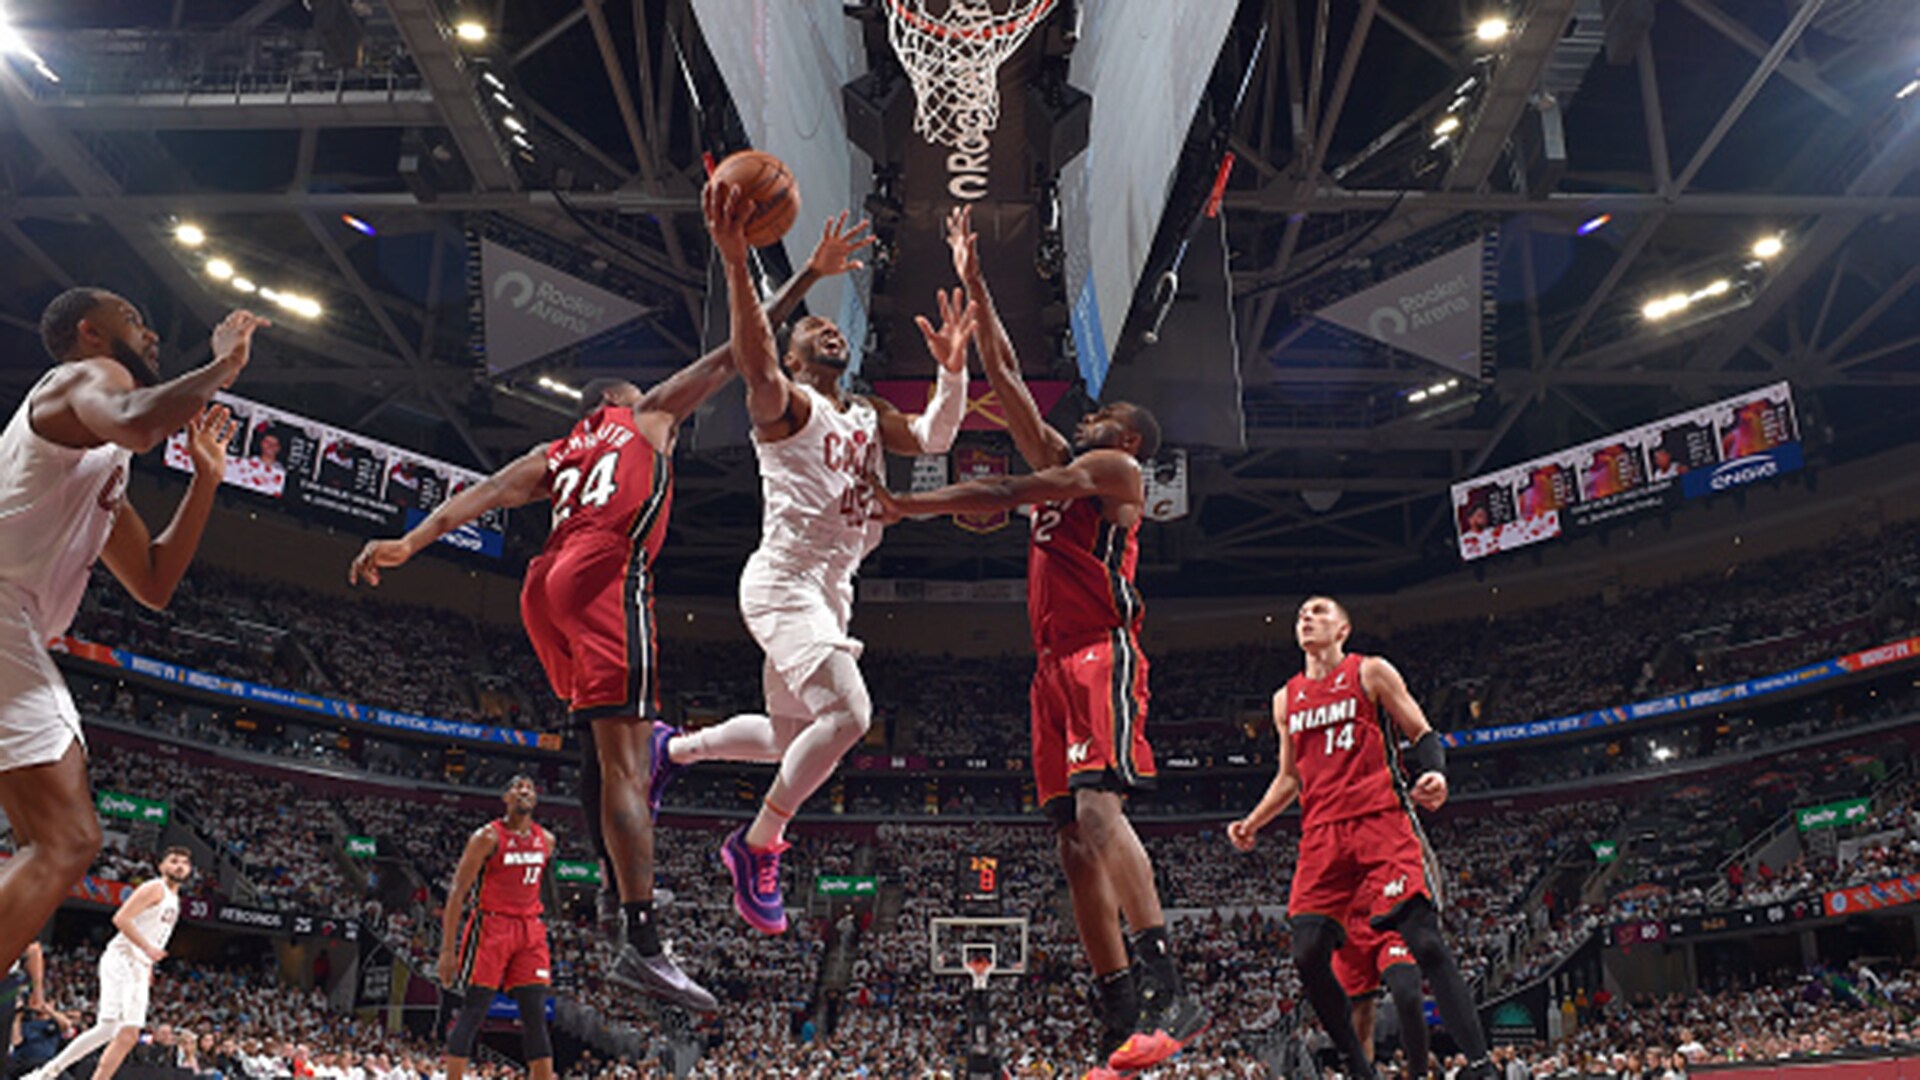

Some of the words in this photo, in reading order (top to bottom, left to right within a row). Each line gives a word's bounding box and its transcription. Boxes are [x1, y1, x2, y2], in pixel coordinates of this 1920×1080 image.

[536, 281, 604, 321] Rocket
[1400, 274, 1469, 315] Rocket
[527, 300, 588, 333] Arena
[1410, 296, 1471, 330] Arena
[551, 451, 619, 522] 24
[1289, 697, 1357, 735] MIAMI
[1325, 722, 1355, 756] 14
[219, 907, 283, 927] REBOUNDS
